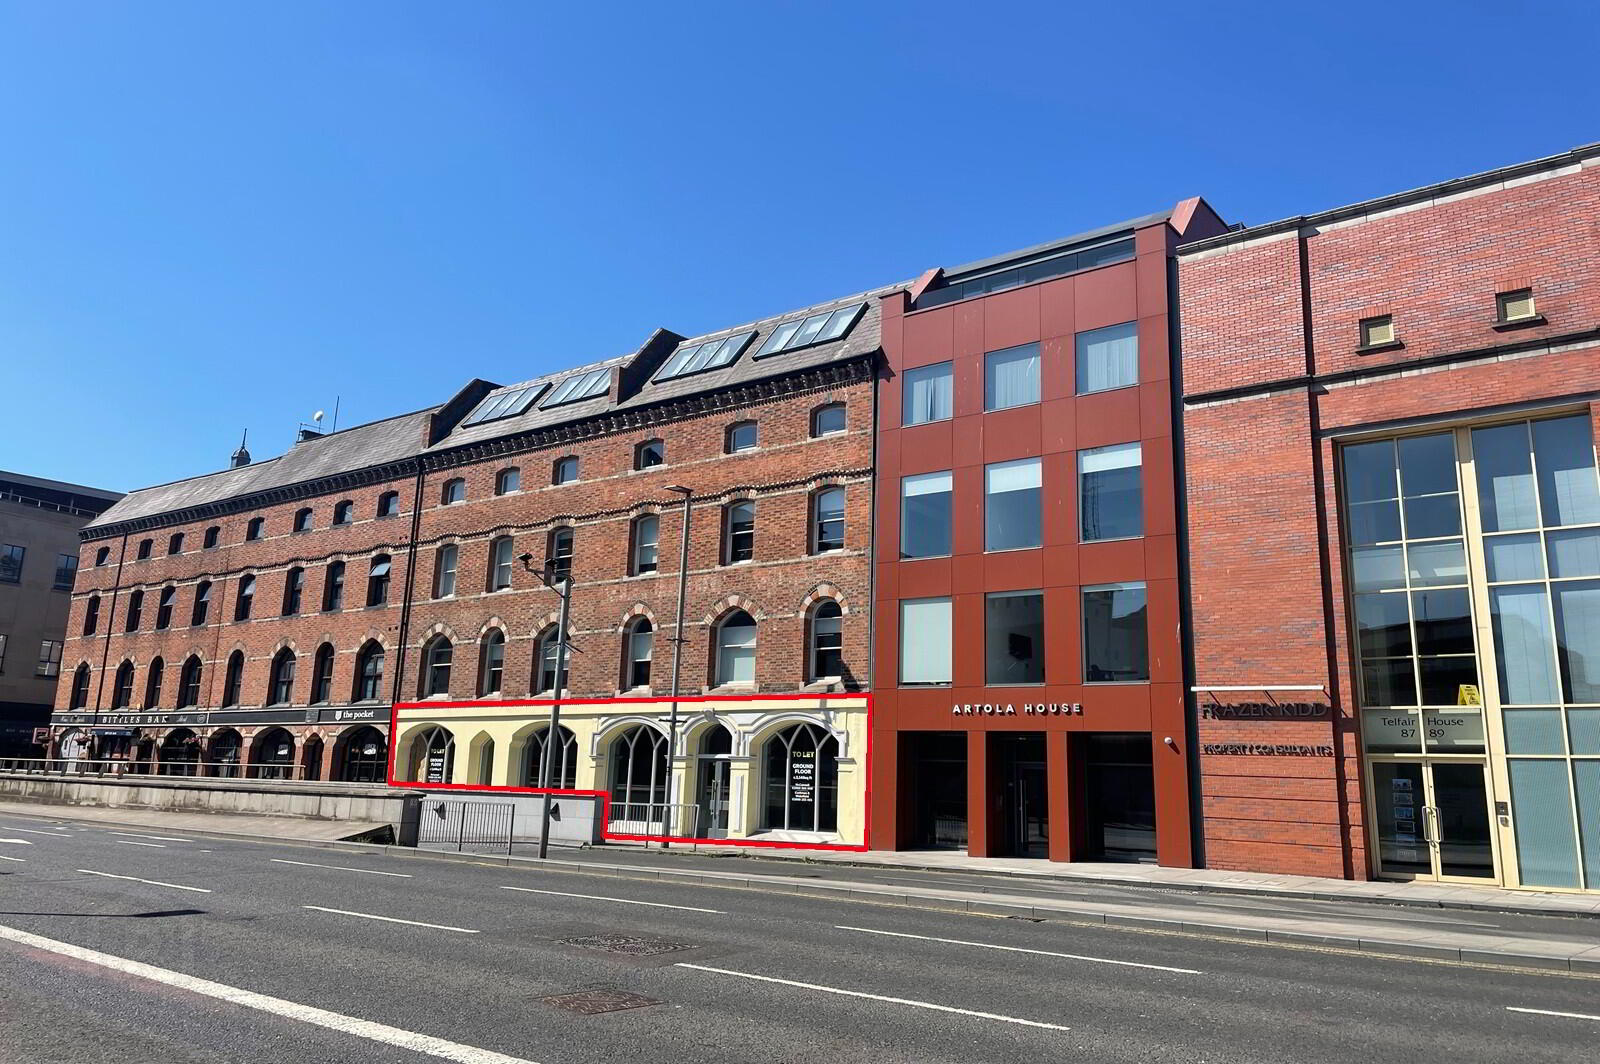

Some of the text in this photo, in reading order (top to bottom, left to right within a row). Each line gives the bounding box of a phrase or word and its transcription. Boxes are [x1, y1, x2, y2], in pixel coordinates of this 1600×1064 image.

[952, 703, 1081, 713] ARTOLA HOUSE
[1203, 703, 1328, 717] FRAZER KIDD
[343, 710, 374, 720] the pocket
[1381, 717, 1464, 726] Telfair House
[1401, 728, 1445, 738] 87 89
